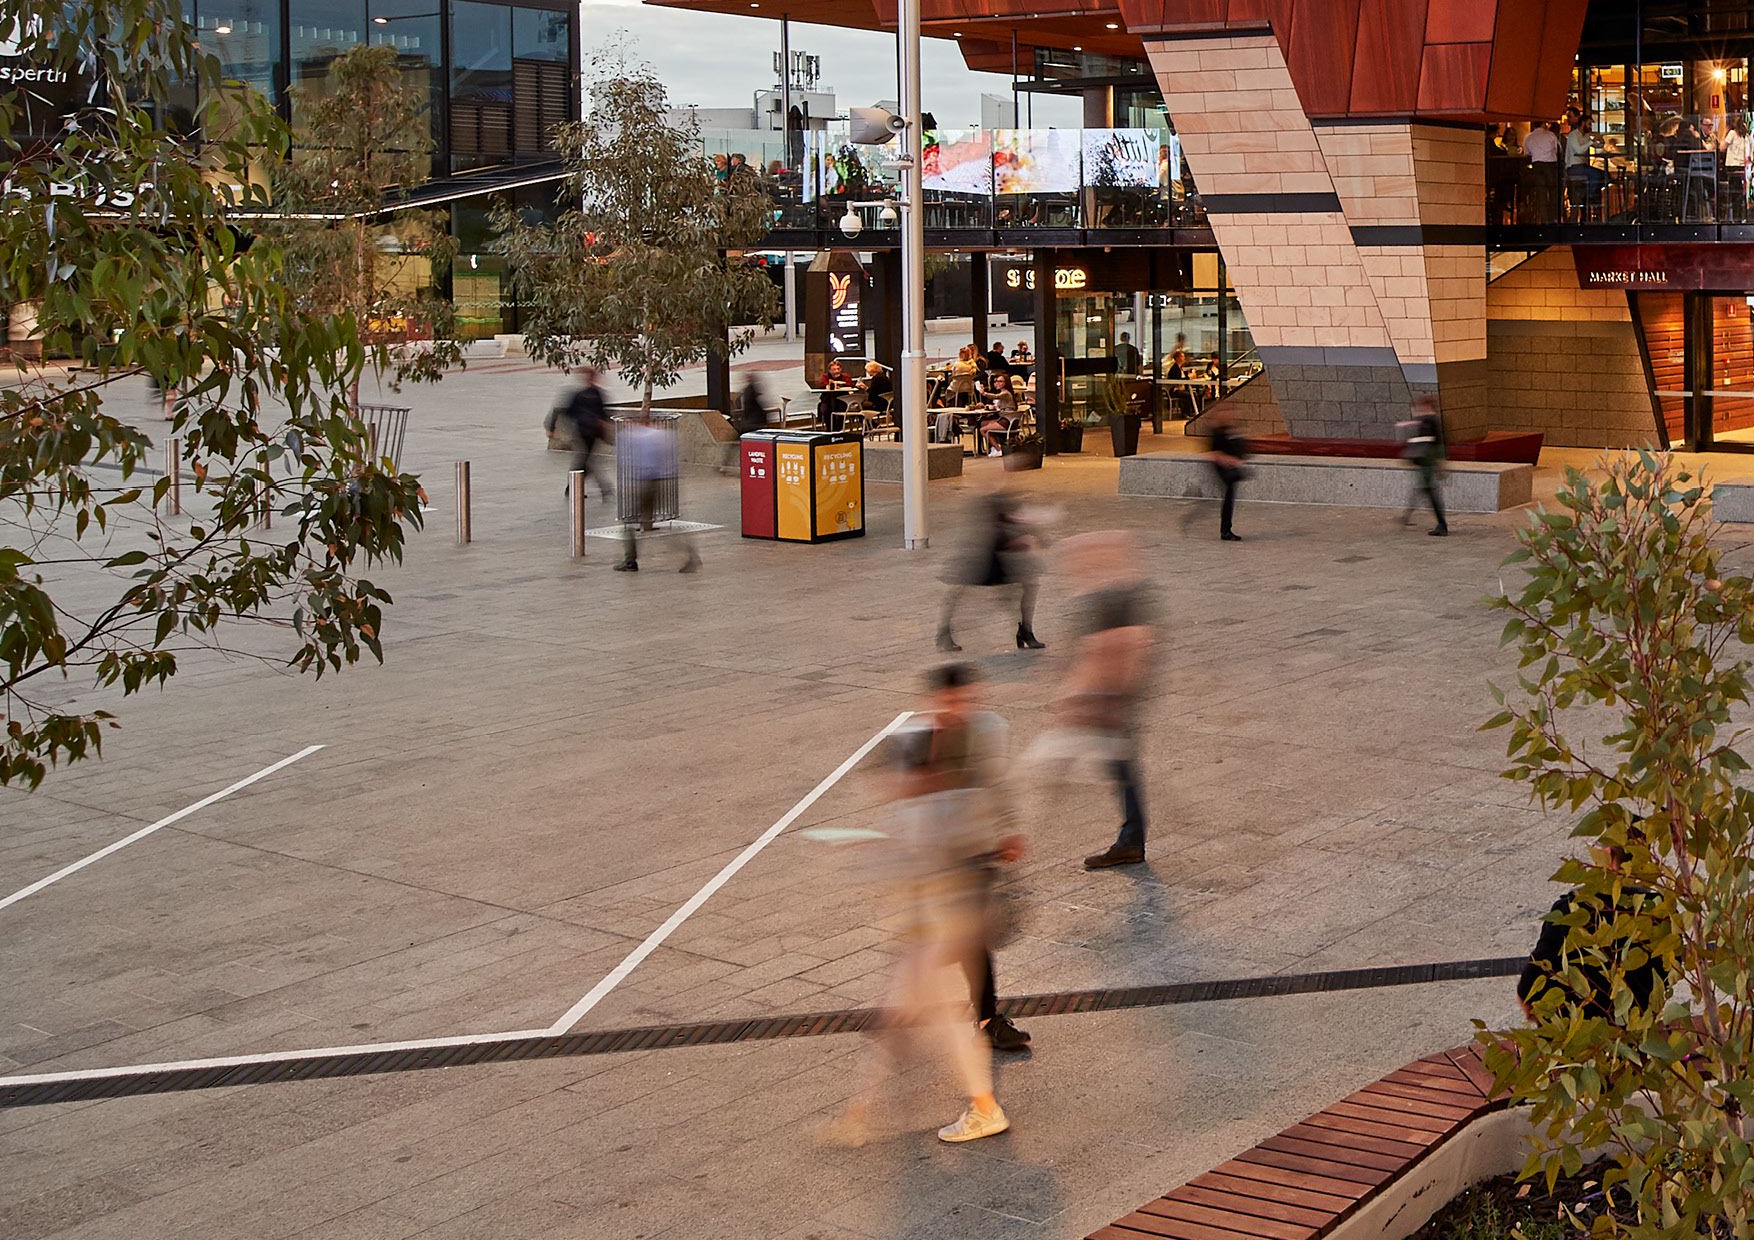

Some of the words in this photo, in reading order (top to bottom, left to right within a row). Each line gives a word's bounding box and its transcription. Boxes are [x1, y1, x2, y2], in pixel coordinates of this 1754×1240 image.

[1589, 270, 1636, 283] MARKET
[1639, 271, 1668, 283] HALL
[823, 452, 853, 460] RECYCLING
